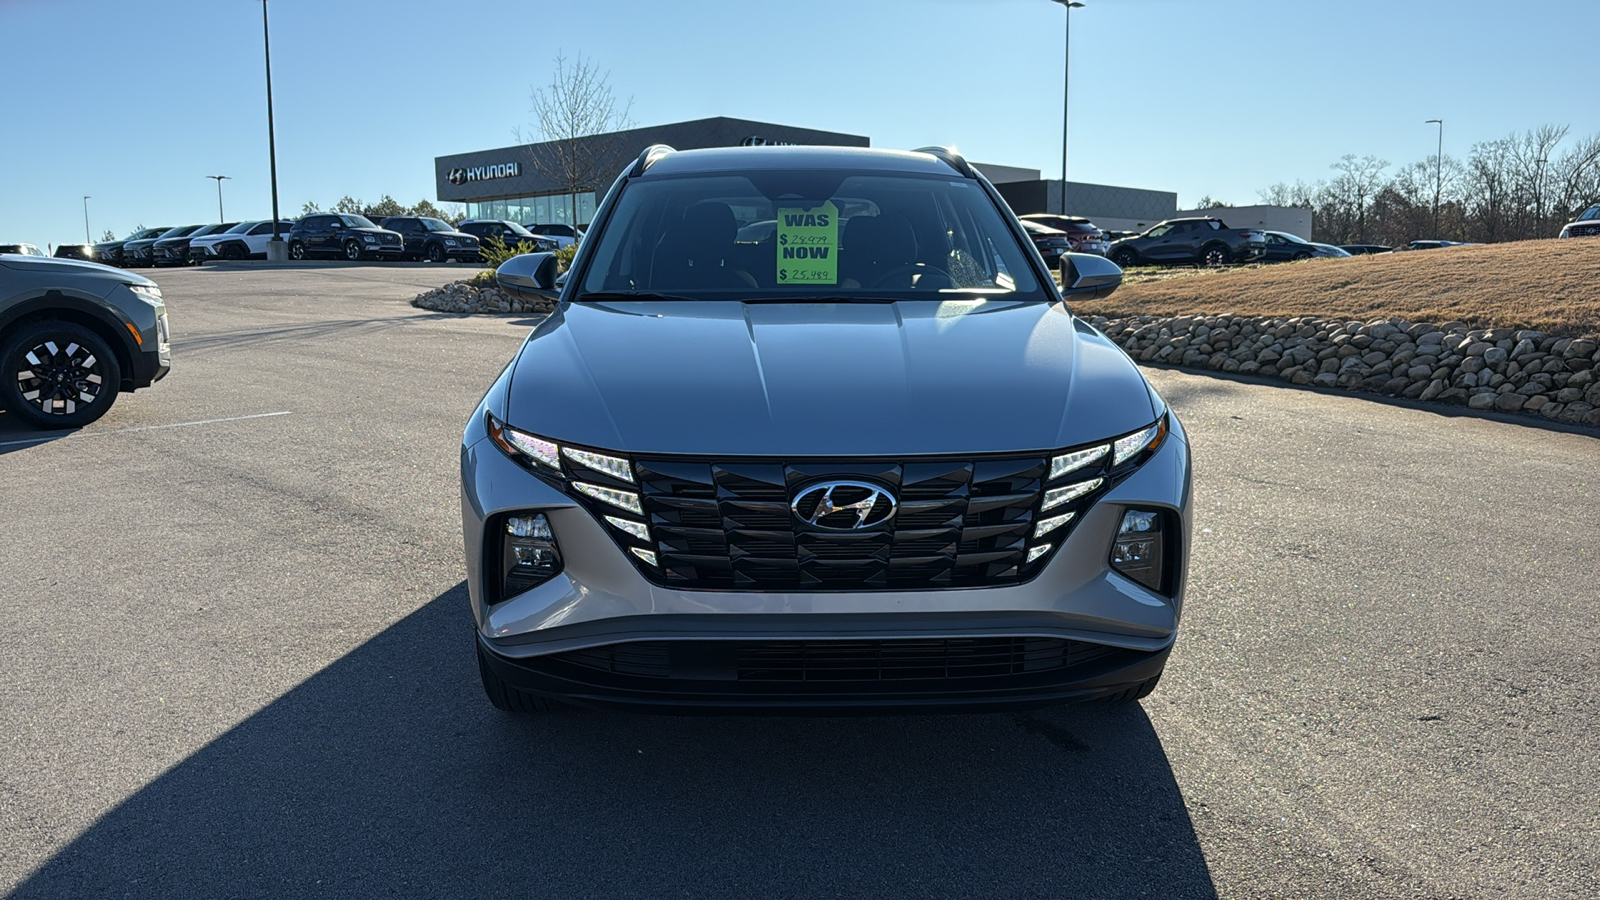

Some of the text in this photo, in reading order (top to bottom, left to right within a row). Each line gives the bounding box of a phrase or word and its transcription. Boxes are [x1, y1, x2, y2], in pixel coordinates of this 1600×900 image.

[467, 162, 518, 181] HYUNDAI
[784, 214, 830, 227] WAS
[779, 233, 788, 246] $
[783, 247, 830, 259] NOW
[779, 268, 829, 281] $ 25,489
